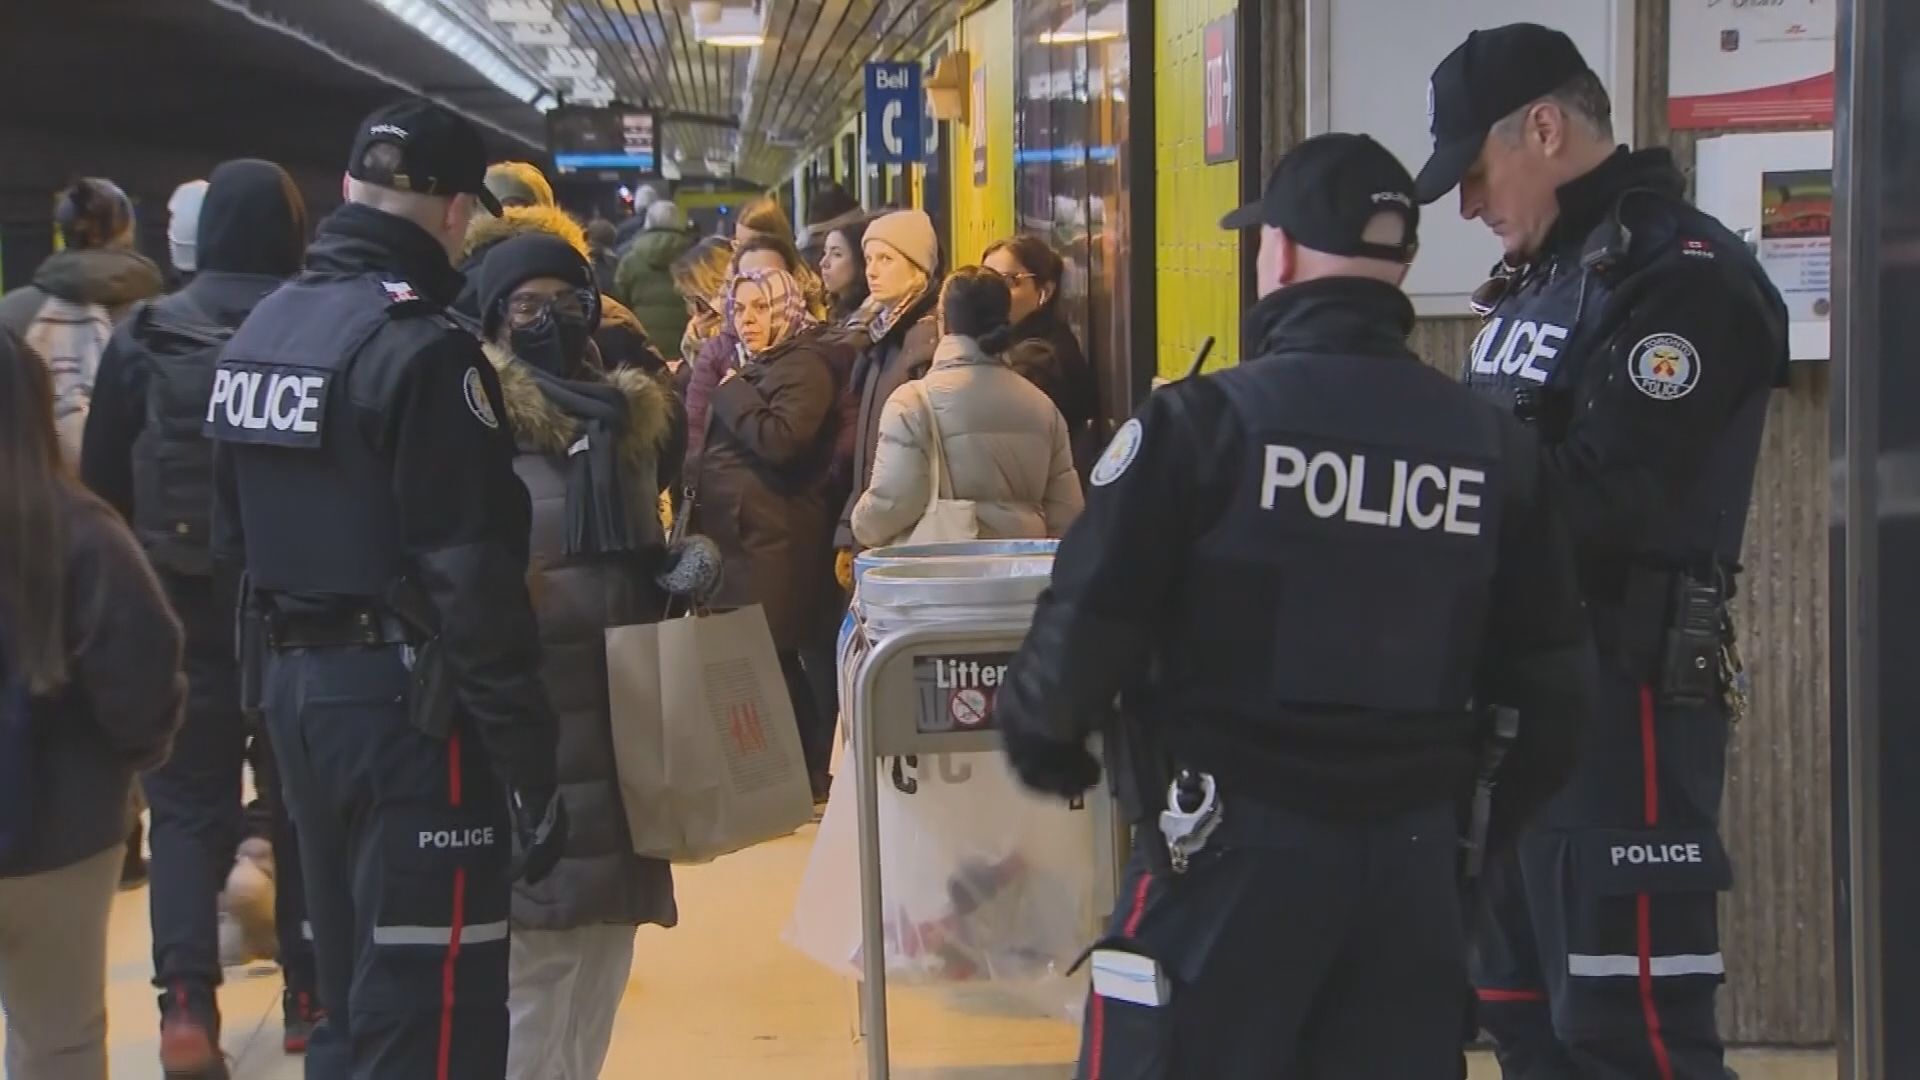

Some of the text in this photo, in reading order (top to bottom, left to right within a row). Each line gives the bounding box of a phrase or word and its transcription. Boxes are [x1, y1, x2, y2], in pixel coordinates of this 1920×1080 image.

[876, 67, 909, 89] Bell
[1471, 317, 1569, 382] OLICE
[206, 368, 324, 433] POLICE
[1260, 444, 1486, 535] POLICE
[936, 659, 1009, 688] Litter
[418, 826, 494, 849] POLICE
[1610, 842, 1702, 866] POLICE
